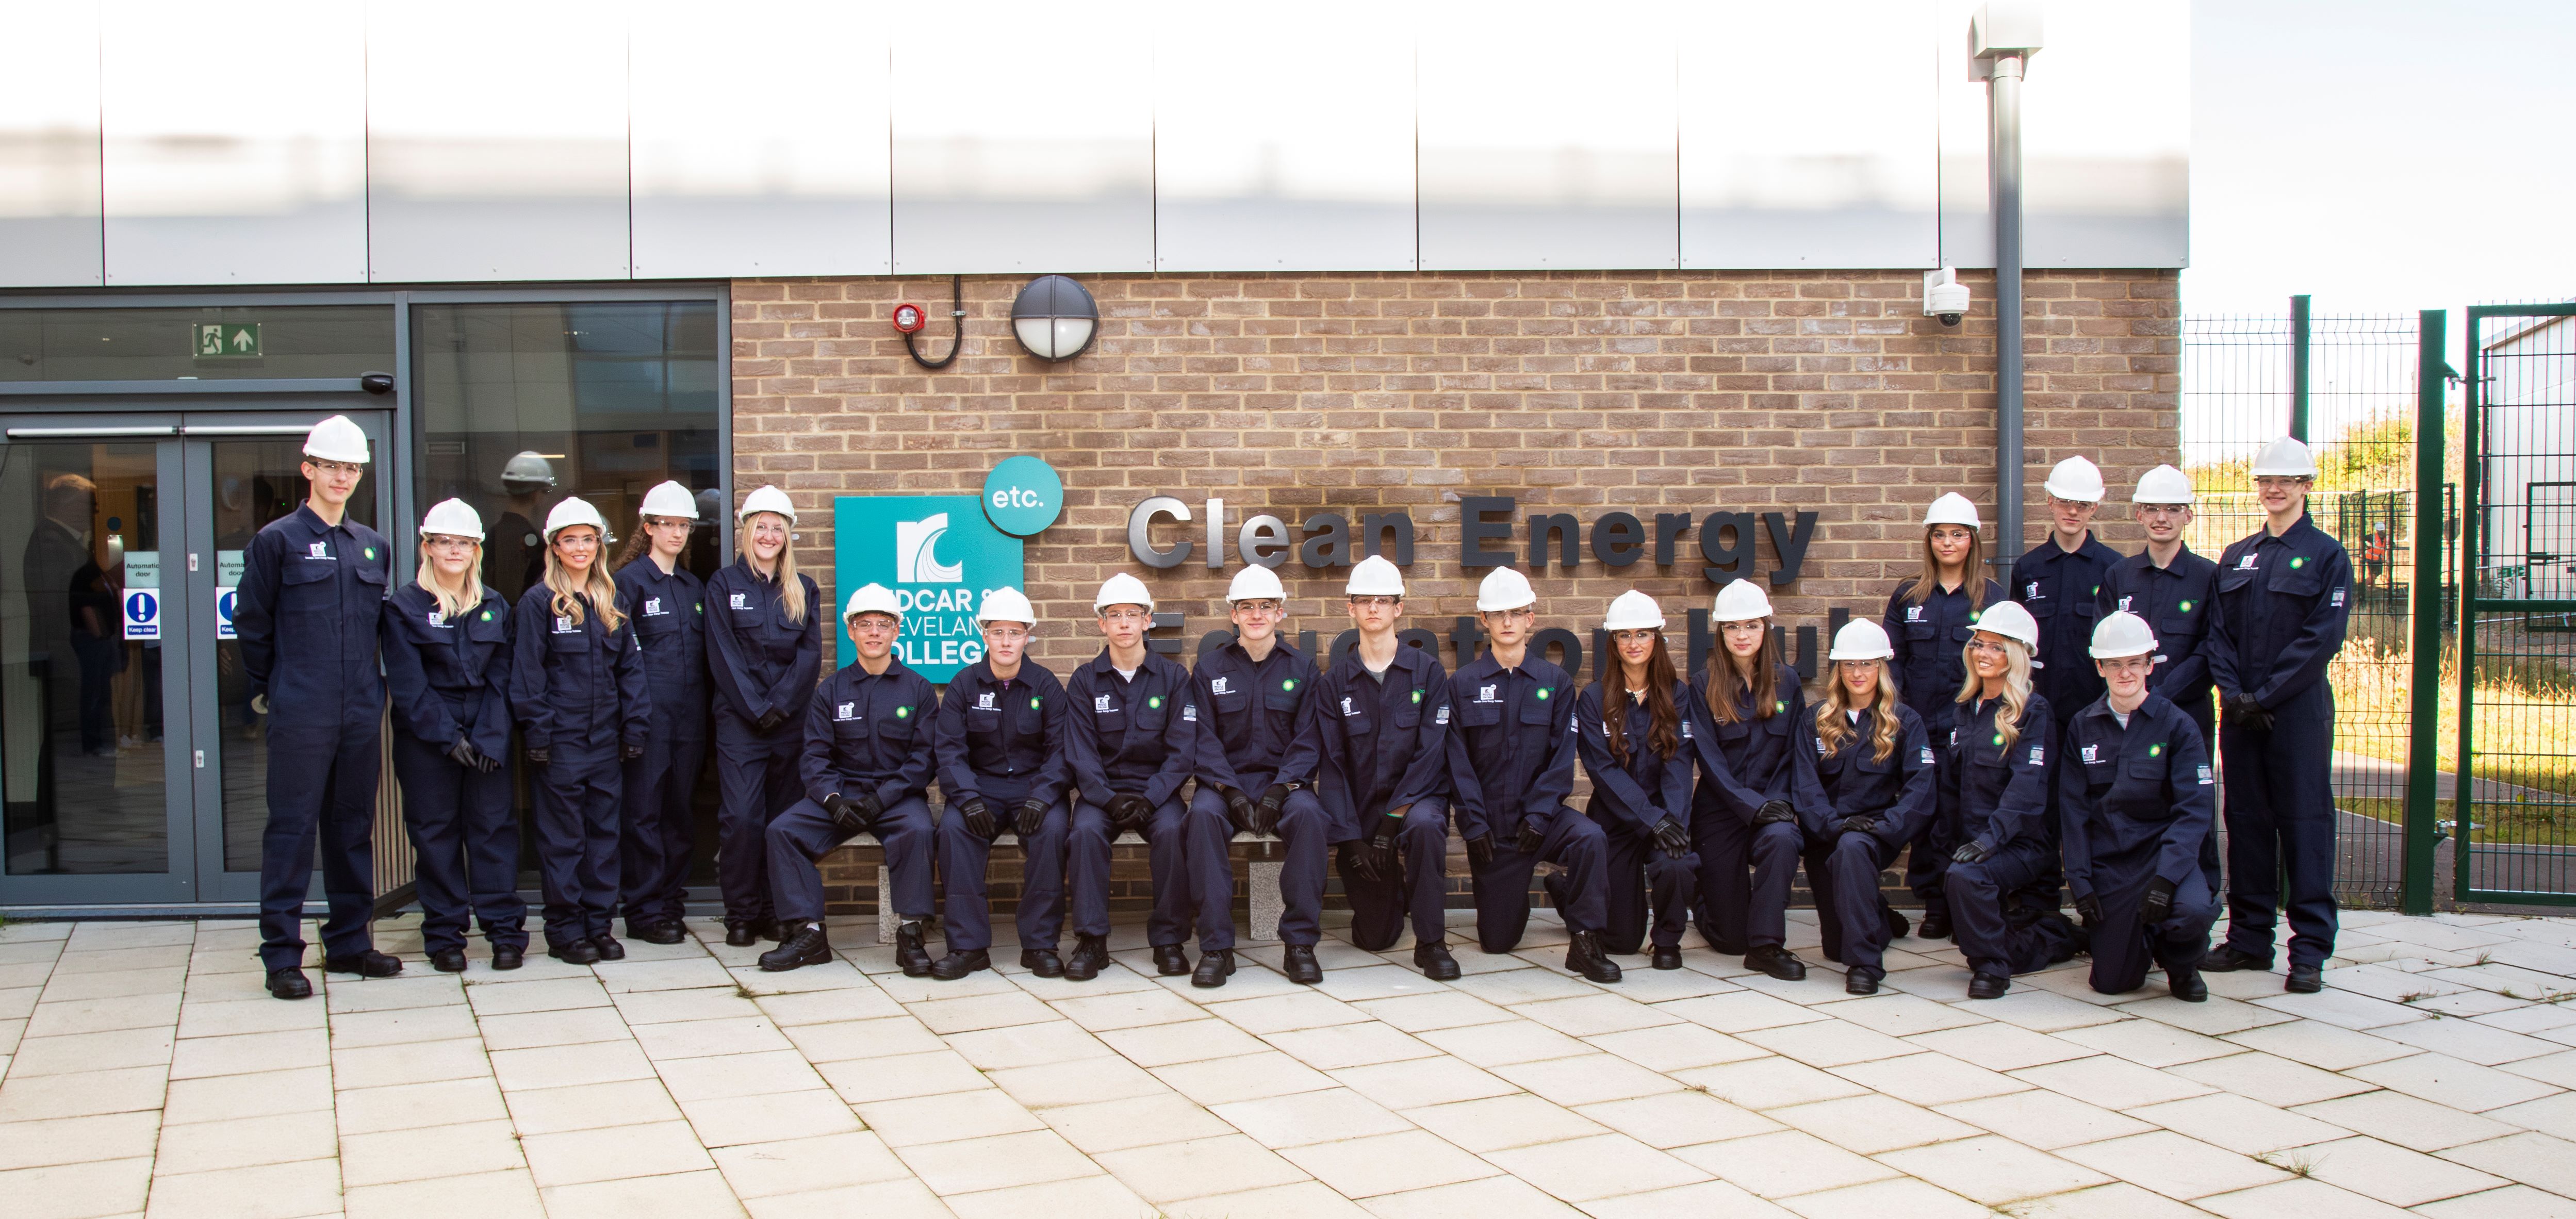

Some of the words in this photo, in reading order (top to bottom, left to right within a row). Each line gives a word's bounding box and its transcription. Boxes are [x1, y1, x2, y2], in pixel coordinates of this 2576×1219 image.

[992, 486, 1044, 508] etc.
[1127, 495, 1414, 568] Clean
[1461, 496, 1819, 585] Energy
[889, 589, 973, 612] DCAR
